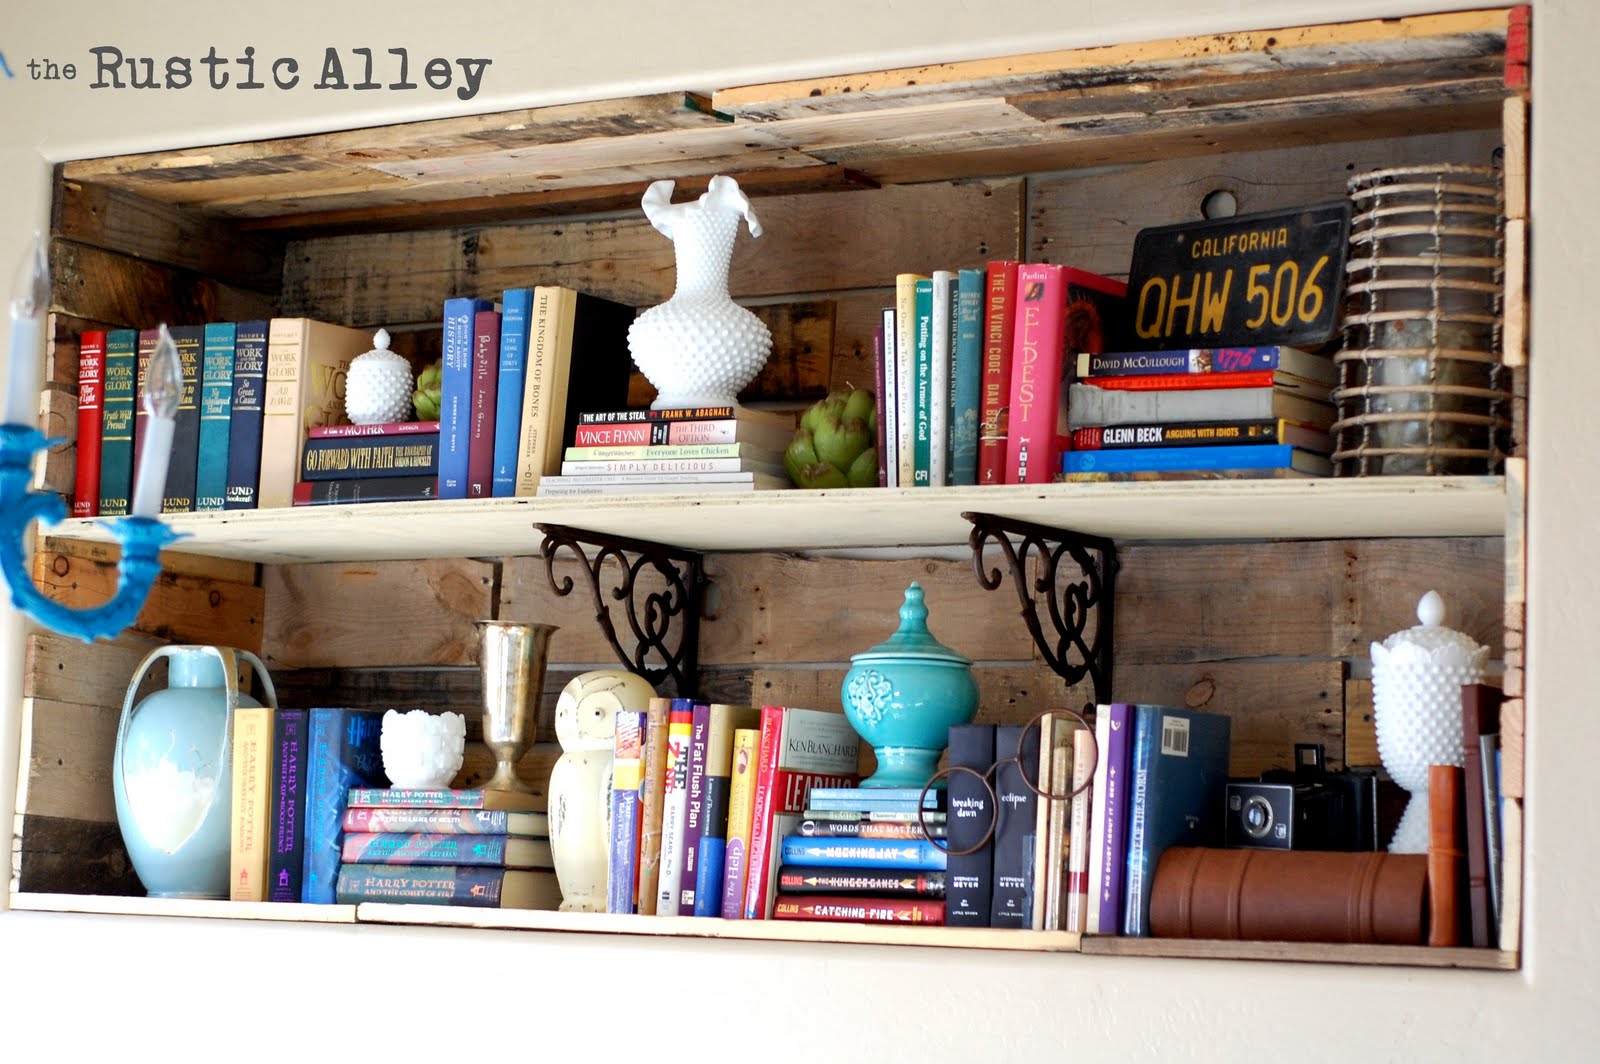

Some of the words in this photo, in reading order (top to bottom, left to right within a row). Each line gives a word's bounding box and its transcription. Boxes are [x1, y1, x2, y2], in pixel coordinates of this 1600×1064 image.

[1191, 227, 1288, 258] CALIFORNIA
[992, 273, 1006, 293] THE
[1023, 271, 1047, 281] Paolini
[991, 296, 1005, 311] DA
[1135, 268, 1233, 338] QHW
[1245, 255, 1328, 328] 506
[540, 295, 549, 316] THE
[918, 316, 930, 349] Putting
[989, 313, 1004, 343] VINCI
[446, 316, 456, 368] HISTORY
[535, 318, 547, 367] KINGDOM
[900, 332, 908, 347] Can
[237, 348, 263, 358] WORK
[271, 353, 297, 362] WORK
[900, 350, 908, 367] Take
[920, 349, 928, 362] on
[987, 347, 1002, 374] CODE
[1218, 347, 1257, 370] 1776
[206, 357, 232, 366] WORK
[235, 361, 263, 371] GLORY
[1019, 306, 1040, 423] ELDEST
[1093, 358, 1121, 370] DAVID
[79, 370, 99, 378] GLORY
[106, 367, 132, 376] WORK
[203, 371, 232, 380] GLORY
[269, 368, 297, 377] GLORY
[533, 368, 542, 383] OF
[919, 363, 929, 377] the
[105, 381, 132, 390] GLORY
[901, 371, 909, 389] Your
[530, 385, 541, 418] BONES
[919, 379, 928, 409] Armor
[986, 383, 1000, 405] DAN
[583, 413, 597, 422] THE
[597, 413, 609, 422] ART
[608, 412, 617, 421] OF
[618, 412, 629, 421] THE
[629, 411, 647, 420] STEAL
[662, 410, 683, 419] FRANK
[684, 409, 694, 417] W.
[696, 407, 731, 417] ABAGNALE
[919, 410, 928, 421] of
[345, 426, 384, 436] MOTHER
[675, 426, 687, 434] THE
[688, 423, 715, 434] THIRD
[918, 421, 928, 441] God
[984, 409, 999, 447] BROWN
[1165, 429, 1197, 439] ARGUING
[1197, 428, 1215, 438] WITH
[1216, 427, 1239, 437] IDIOTS
[580, 431, 611, 444] VINCE
[613, 429, 646, 443] FLYNN
[678, 434, 710, 443] OPTION
[1103, 428, 1135, 444] GLENN
[1136, 428, 1162, 443] BECK
[307, 449, 318, 471] GO
[318, 449, 349, 470] FORWARD
[350, 448, 371, 469] WITH
[372, 447, 394, 469] FAITH
[646, 448, 678, 458] Everyone
[679, 449, 701, 457] Loves
[701, 447, 730, 456] Chicken
[607, 463, 649, 472] SIMPLY
[653, 462, 715, 471] DELICIOUS
[915, 470, 928, 480] CFI
[227, 486, 253, 496] LUND
[101, 499, 127, 507] LUND
[163, 498, 189, 506] LUND
[197, 497, 224, 505] LUND
[695, 723, 705, 740] The
[693, 742, 705, 762] Fat
[762, 717, 774, 774] BLANCHARD
[789, 738, 807, 753] KEN
[806, 740, 858, 758] BLANCHARD
[248, 741, 257, 793] HARRY
[288, 741, 298, 794] HARRY
[674, 746, 690, 790] THE
[690, 764, 704, 798] Flush
[1136, 769, 1147, 805] STORM
[755, 785, 766, 822] LEADING
[952, 797, 984, 810] breaking
[1001, 793, 1027, 811] eclipse
[667, 805, 676, 831] BARRY
[688, 800, 701, 828] Plan
[957, 808, 977, 818] dawn
[1134, 804, 1145, 826] THE
[245, 800, 255, 852] POTTER
[285, 799, 296, 852] POTTER
[829, 824, 859, 833] WORDS
[861, 825, 884, 834] THAT
[886, 826, 923, 835] MATTER
[369, 839, 409, 848] HARRY
[414, 840, 458, 850] POTTER
[785, 847, 806, 856] COLLINS
[1105, 875, 1111, 887] NO
[1108, 807, 1114, 816] IT
[826, 847, 899, 860] MOCKINGJAY
[727, 846, 743, 880] Help
[365, 877, 410, 889] HARRY
[412, 879, 456, 890] POTTER
[782, 876, 803, 886] COLLINS
[831, 878, 869, 888] HUNGER
[870, 879, 900, 889] GAMES
[435, 890, 456, 898] FIRE
[728, 880, 737, 898] The
[778, 903, 800, 914] COLLINS
[815, 905, 867, 919] CATCHING
[870, 908, 895, 921] FIRE
